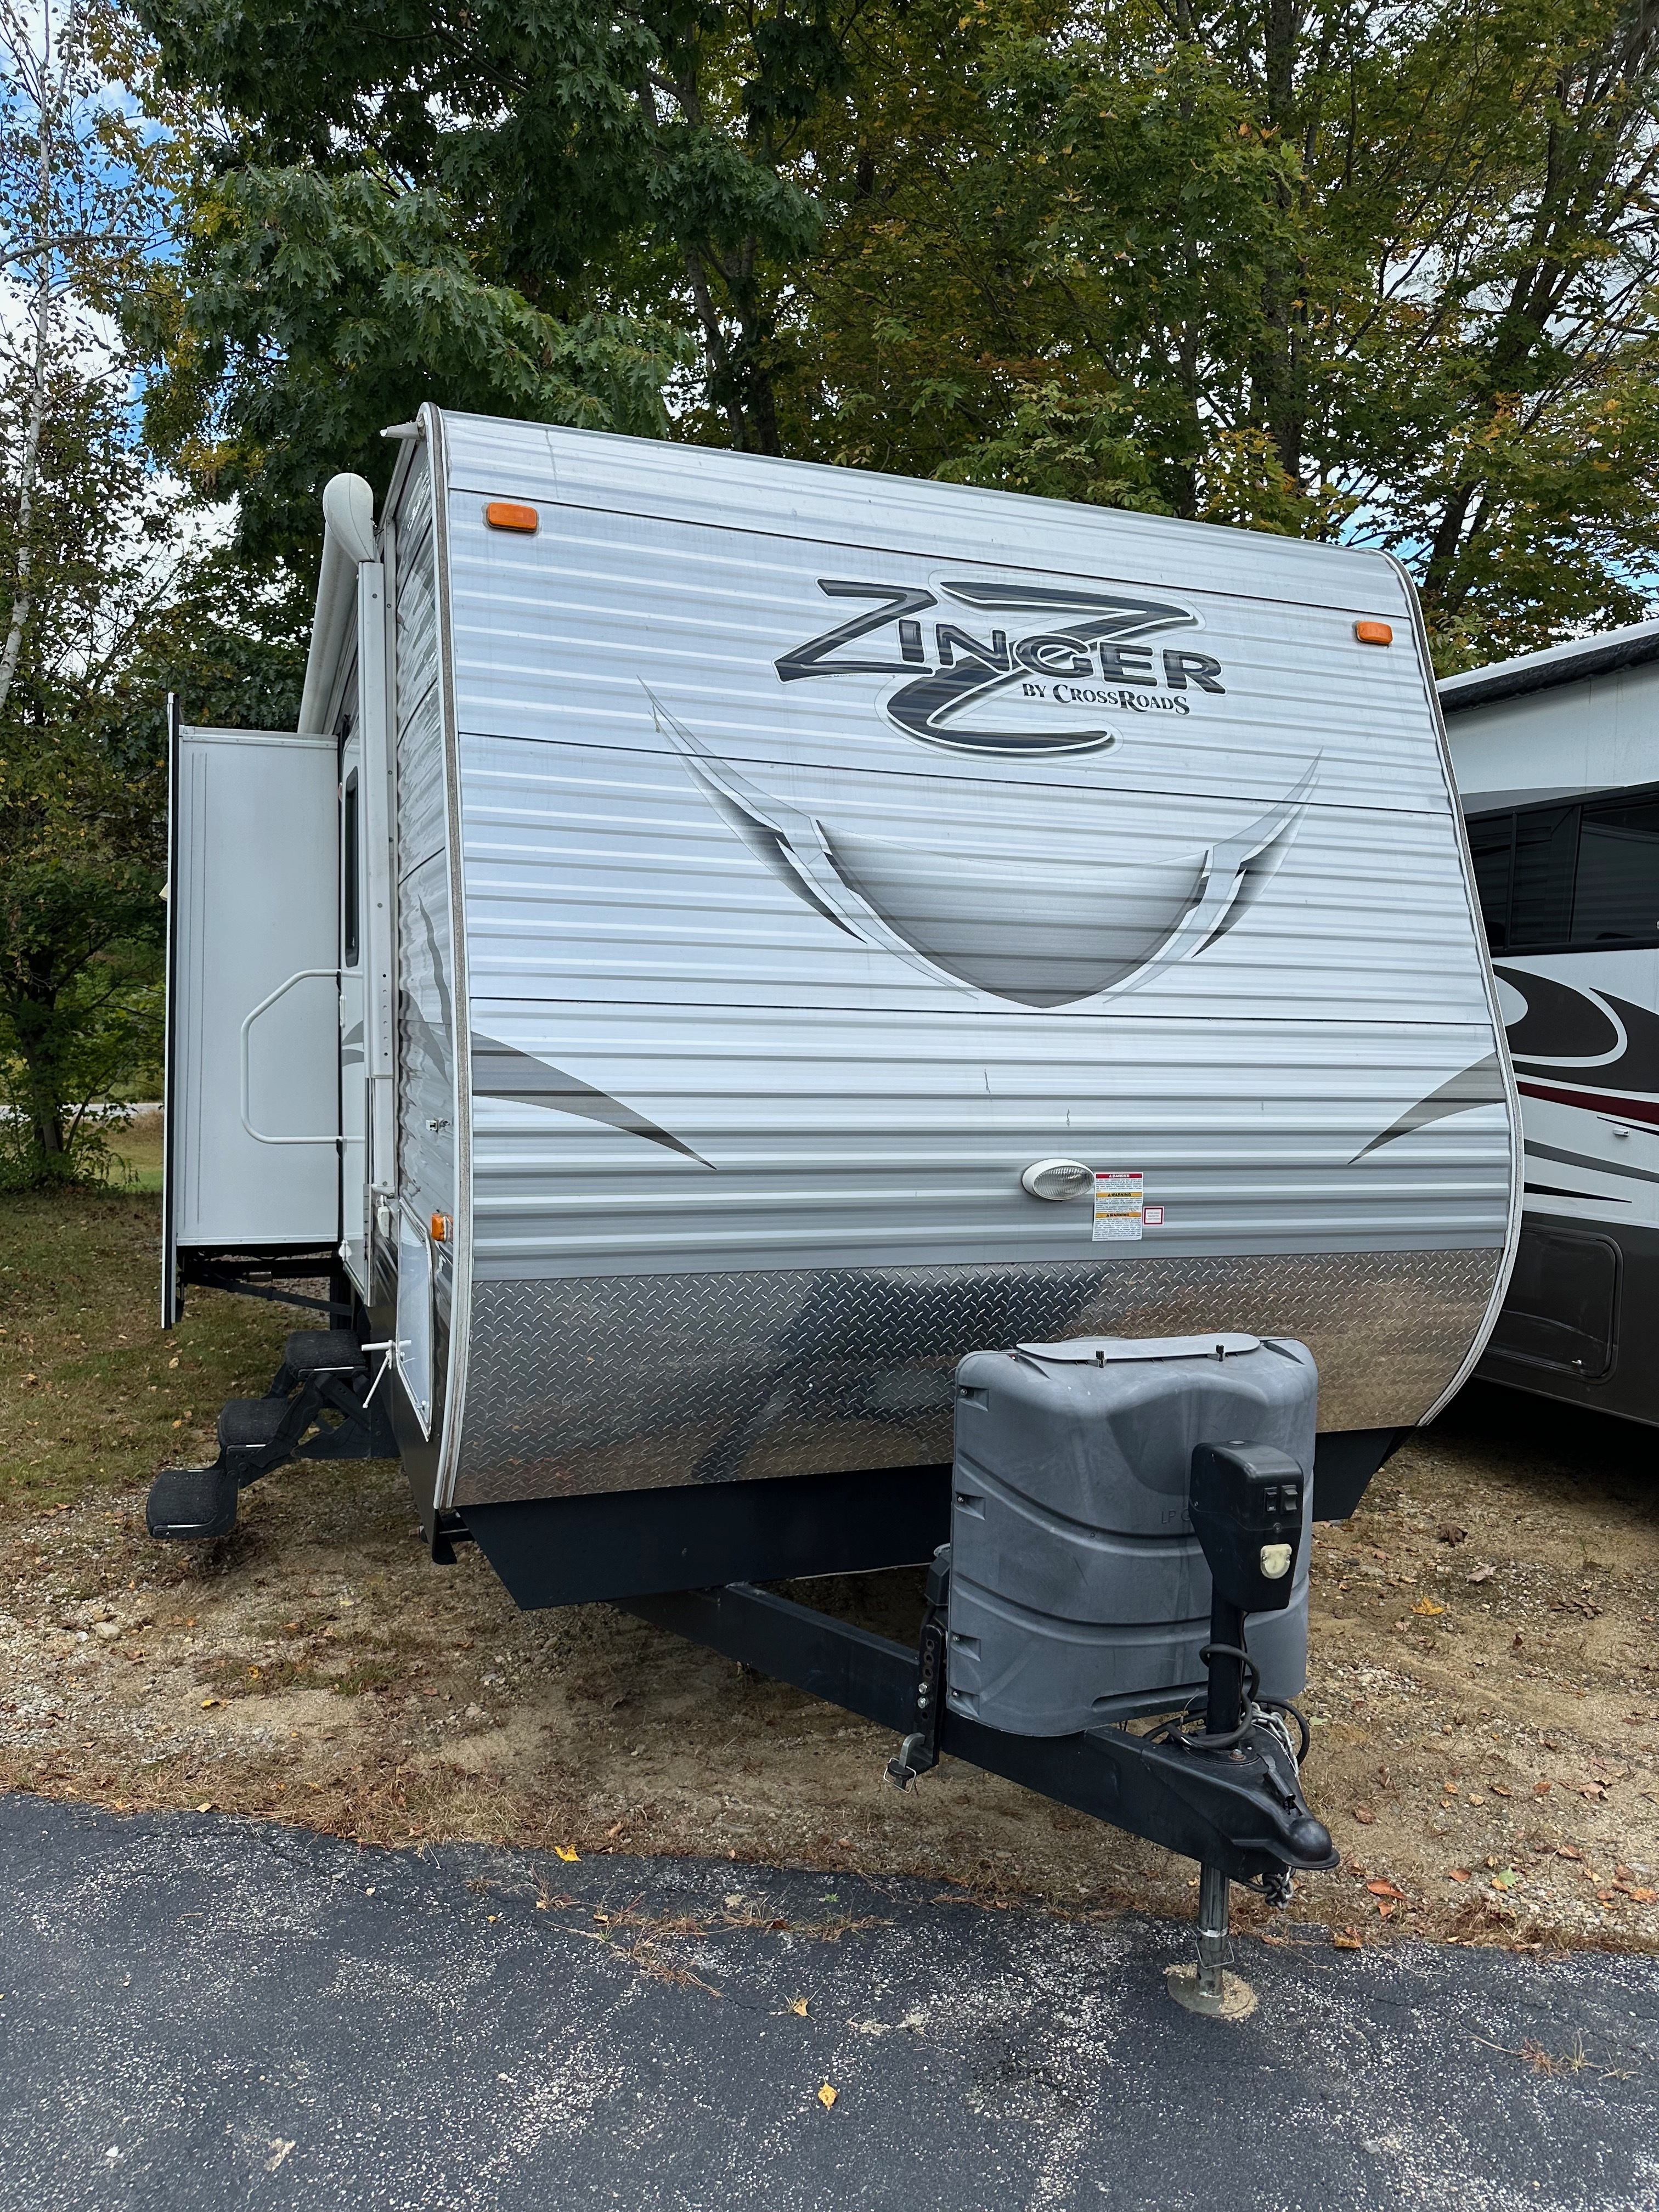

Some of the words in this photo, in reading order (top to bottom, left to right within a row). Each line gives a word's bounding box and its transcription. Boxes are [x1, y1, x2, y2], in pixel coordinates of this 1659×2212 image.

[774, 579, 1227, 696] ZINGER
[1022, 683, 1046, 698] BY
[1161, 1509, 1176, 1524] LP
